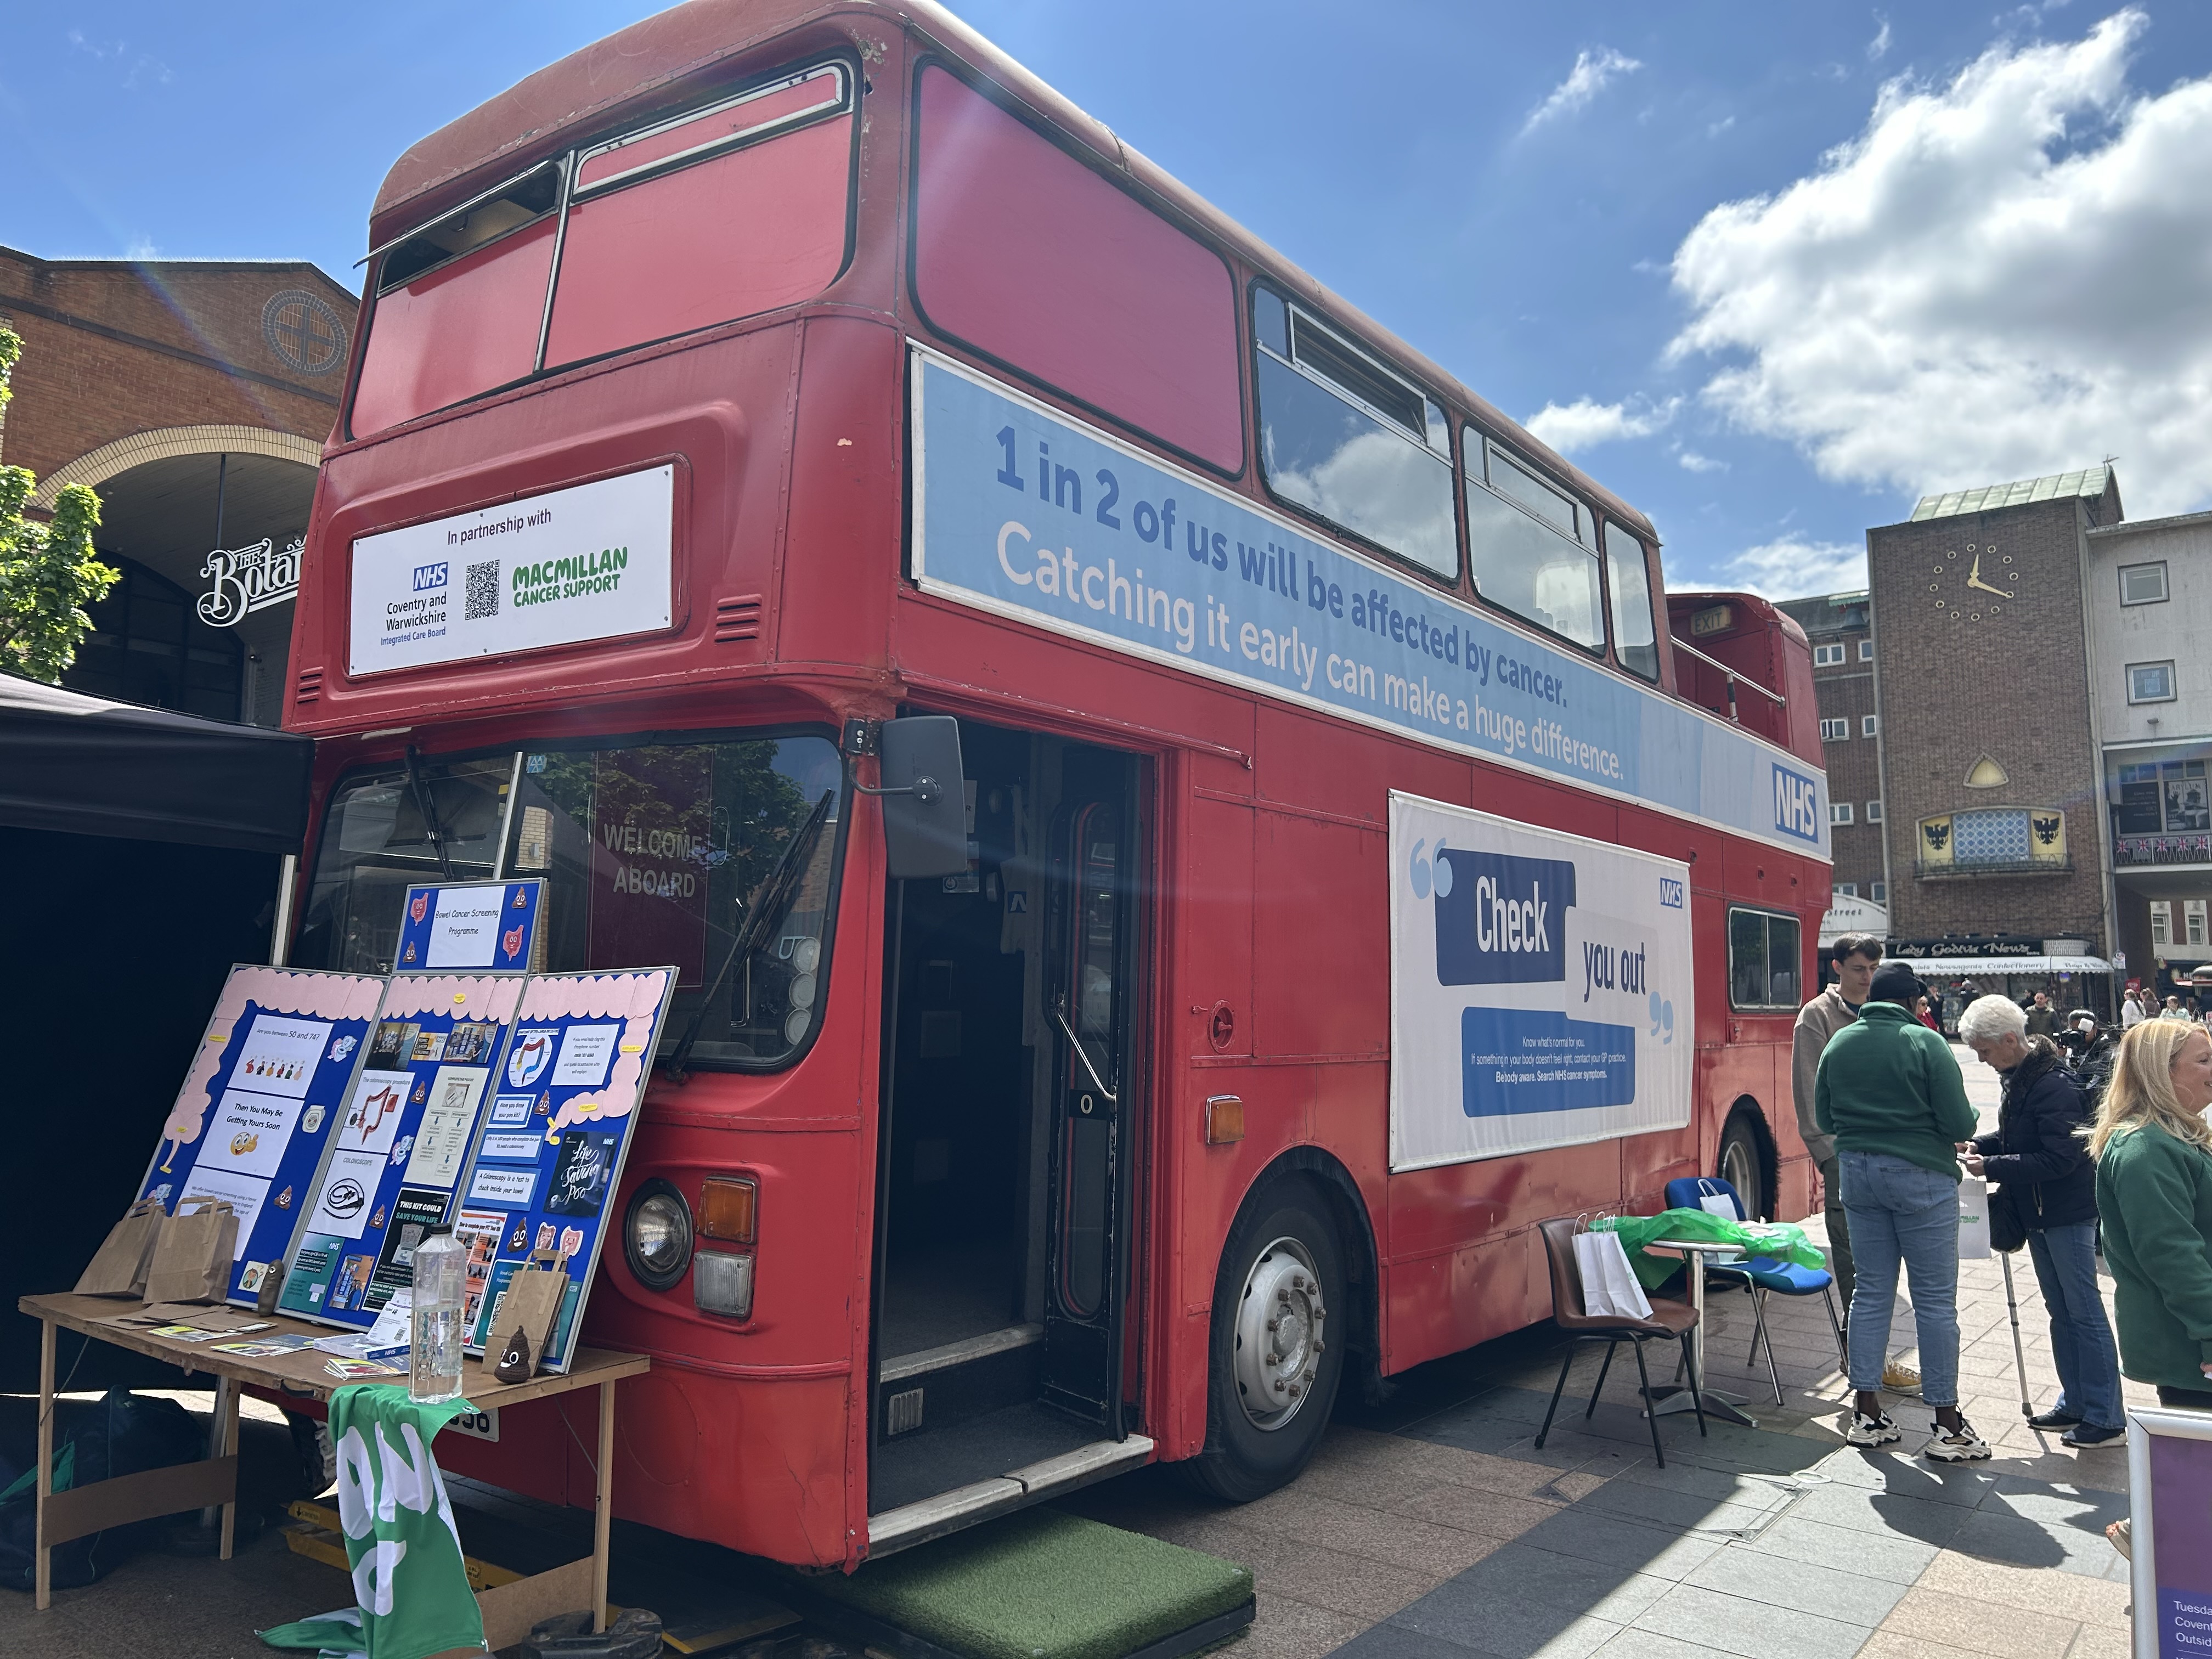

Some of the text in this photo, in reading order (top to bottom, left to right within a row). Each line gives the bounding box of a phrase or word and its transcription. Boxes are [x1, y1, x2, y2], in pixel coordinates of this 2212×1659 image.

[447, 509, 551, 545] In partnership with
[238, 550, 262, 569] THE
[512, 546, 628, 591] MACMILLAN
[996, 425, 1567, 707] 1 in 2 of us will be affected by cancer.
[414, 563, 447, 590] NHS
[514, 574, 620, 608] CANCER SUPPORT
[387, 592, 447, 616] Coventry and
[386, 610, 446, 631] Warwickshire
[1695, 611, 1722, 633] EXIT
[381, 627, 446, 646] Integrated Care Board
[997, 521, 1624, 780] Catching it early can make a huge difference.
[1776, 770, 1815, 837] NHS
[604, 823, 702, 860] WELCOME
[613, 867, 695, 898] ABOARD
[1661, 882, 1682, 907] NHS
[436, 909, 499, 919] Bowel Cancer Screening
[1476, 875, 1549, 953] Check
[1827, 909, 1861, 917] Street
[448, 927, 478, 937] Programme
[1895, 942, 2030, 957] Lady Godiva News
[1583, 941, 1646, 1002] you out
[1522, 1036, 1537, 1048] Know
[1537, 1036, 1552, 1047] what's
[1553, 1037, 1569, 1047] normal
[1575, 1038, 1585, 1050] you.
[1471, 1052, 1627, 1067] If something in your body doesn't feel right, contact your GP practice.
[1496, 1069, 1607, 1085] Be body aware. Search NHS cancer symptoms.
[235, 1103, 248, 1111] Then
[261, 1107, 275, 1117] May
[227, 1115, 280, 1130] Getting Yours Soon
[343, 1157, 373, 1166] COLONOSCOPE
[571, 1140, 599, 1169] Life
[483, 1173, 506, 1182] Colonoscopy
[561, 1164, 600, 1189] Saving
[422, 1204, 442, 1212] COULD
[396, 1212, 438, 1224] SAVE YOUR LIFE
[2173, 1600, 2212, 1616] Tuesda
[2175, 1616, 2212, 1632] Covent
[2176, 1632, 2212, 1647] Outsid
